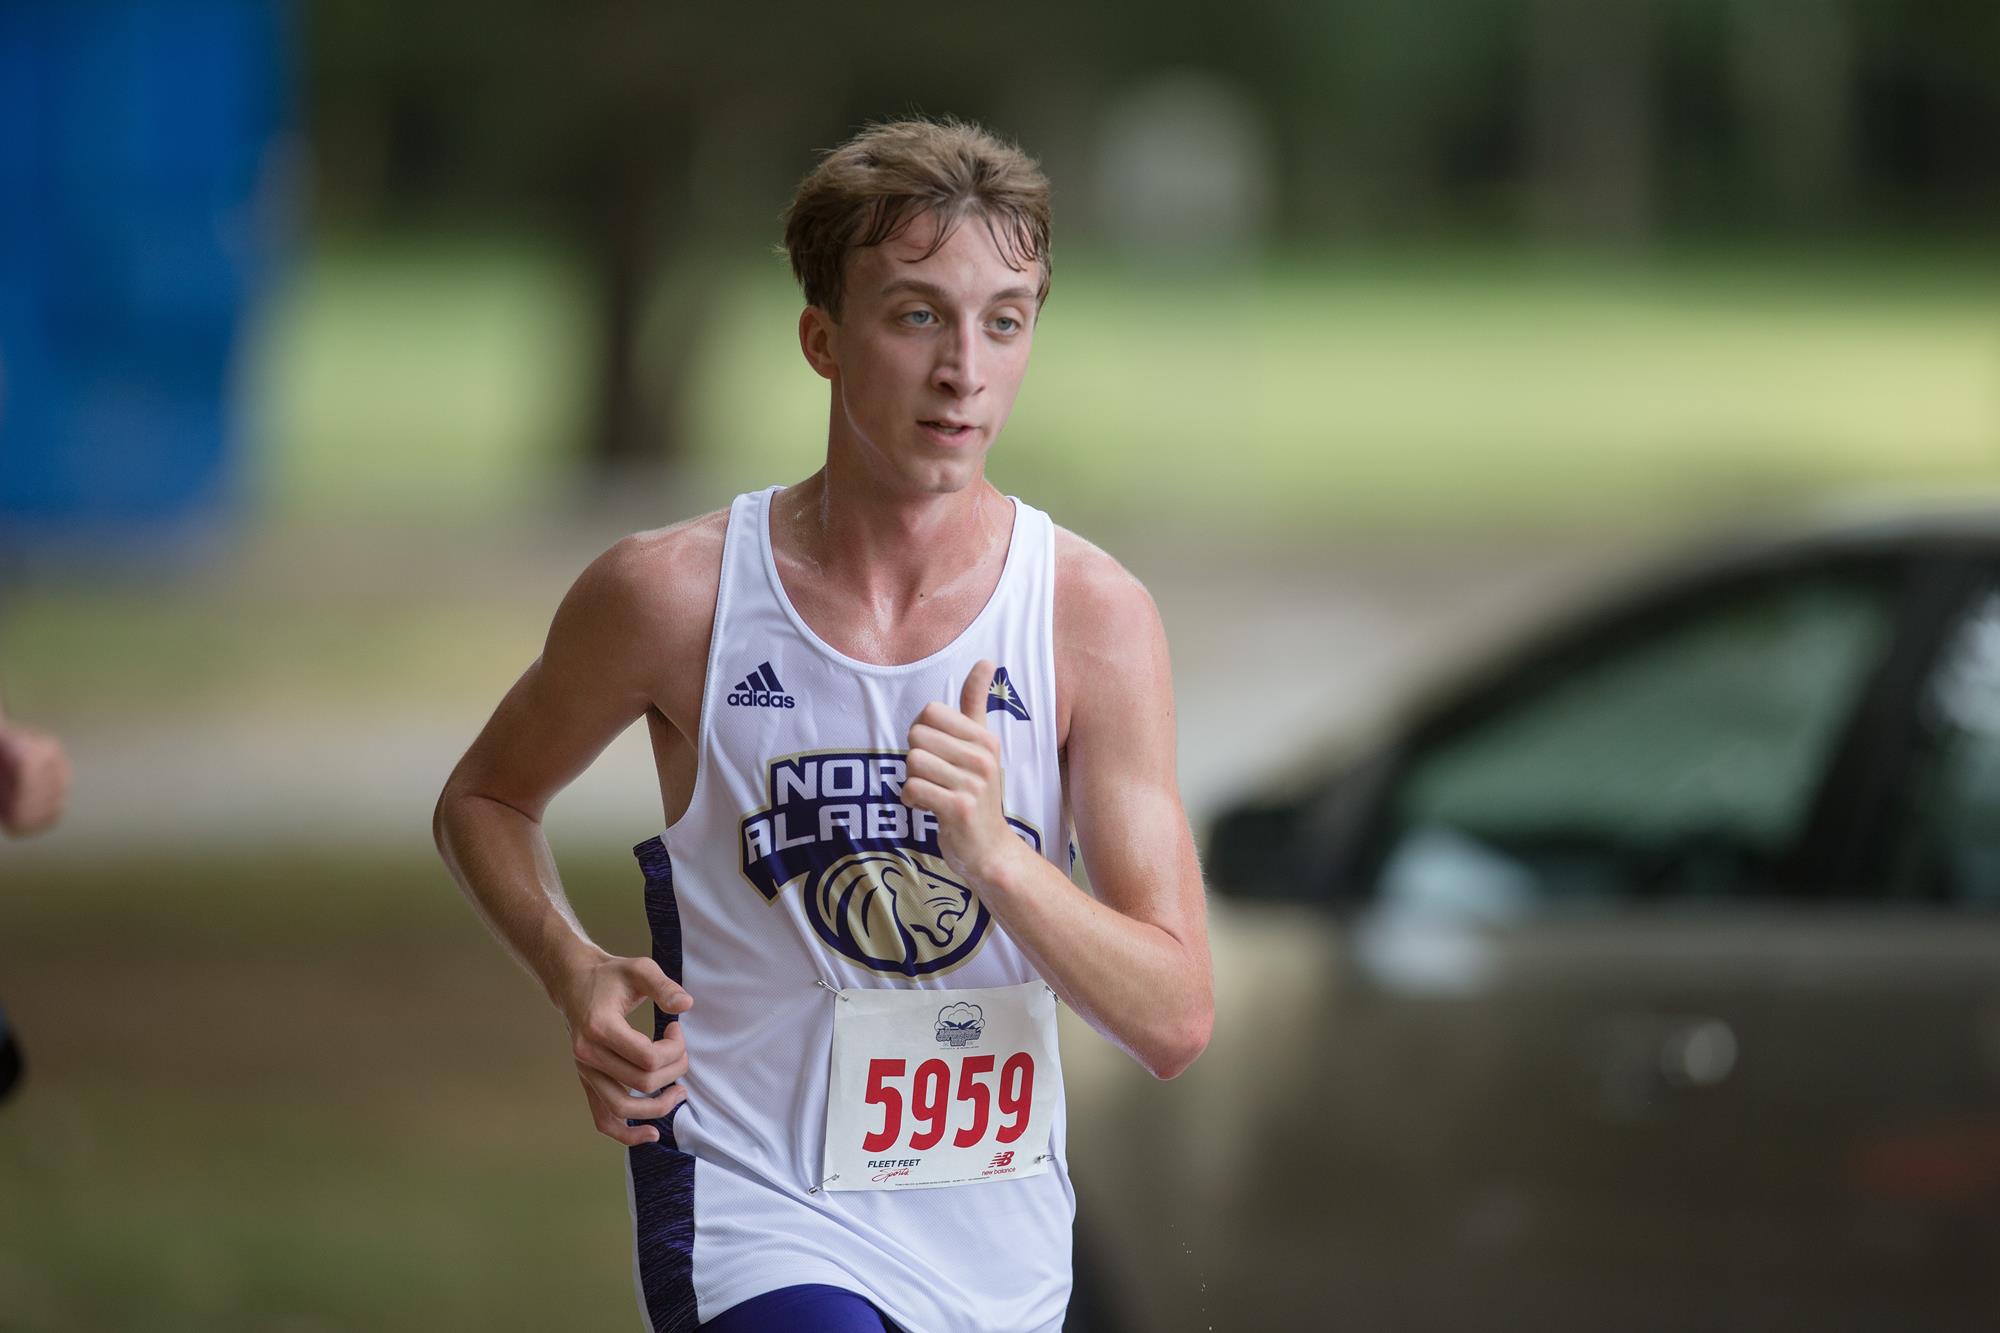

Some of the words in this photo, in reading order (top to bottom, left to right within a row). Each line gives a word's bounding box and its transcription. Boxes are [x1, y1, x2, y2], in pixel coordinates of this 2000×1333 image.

[727, 689, 795, 709] adidas
[776, 758, 908, 806] NOR
[744, 803, 1037, 865] ALABA
[862, 1051, 1035, 1153] 5959
[867, 1160, 896, 1168] FLEET
[898, 1158, 921, 1167] FEET
[994, 1166, 1016, 1175] balance
